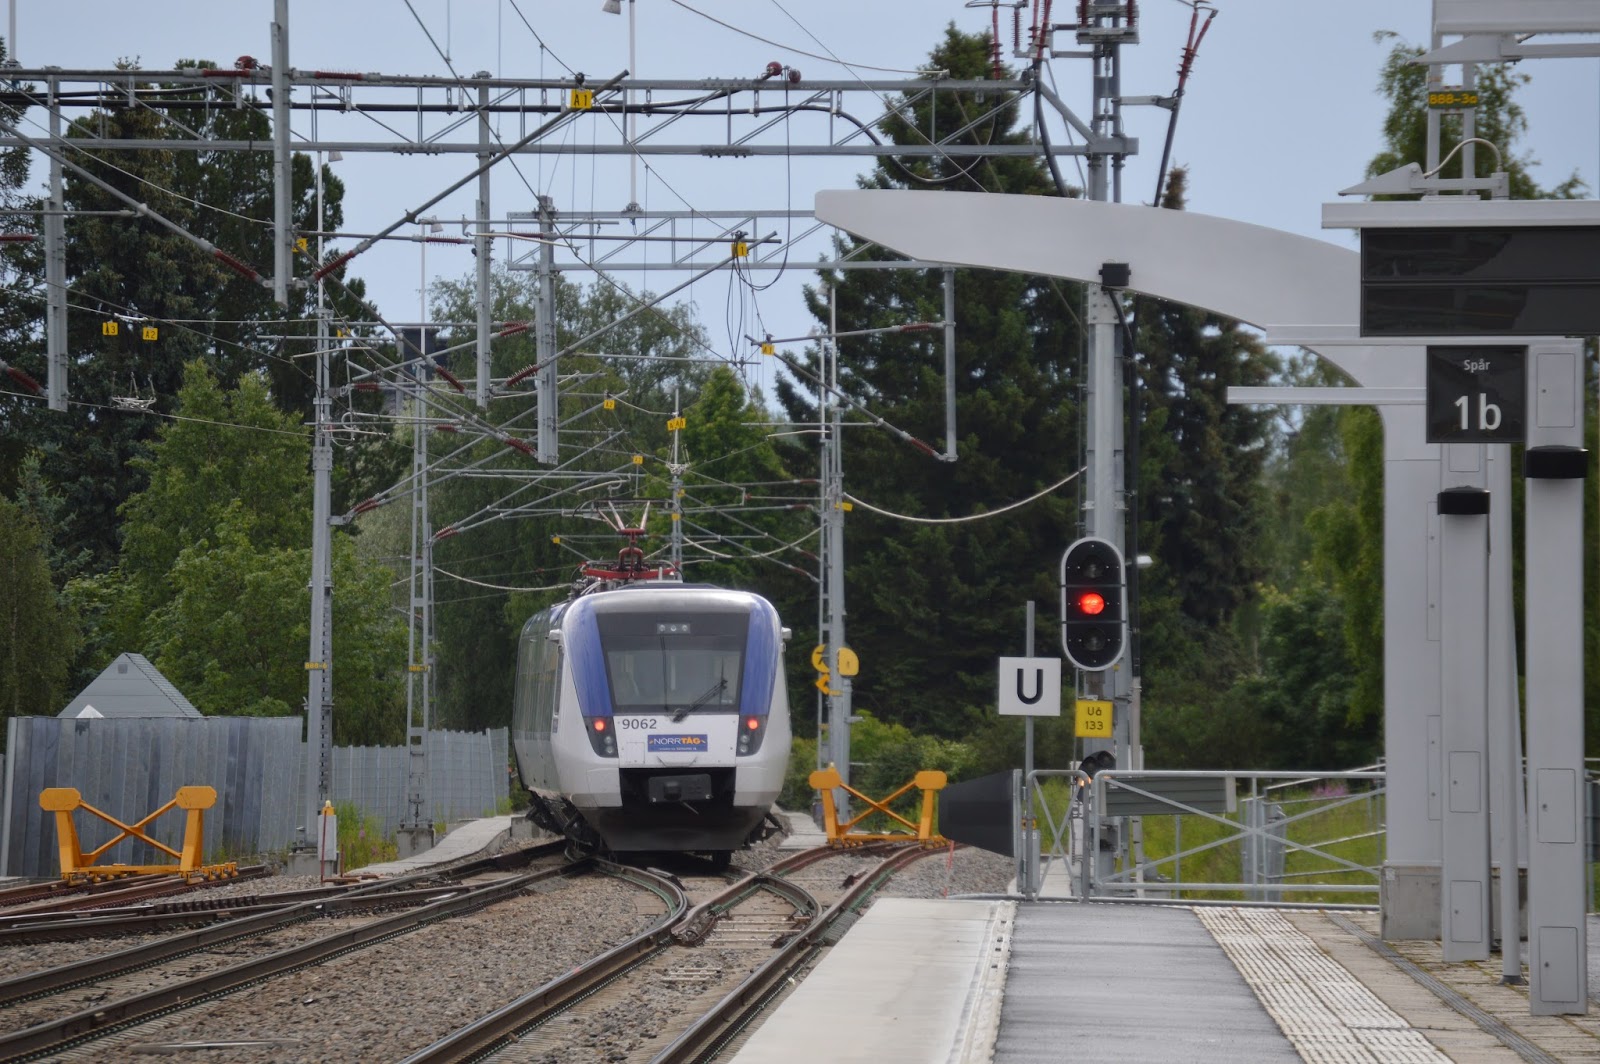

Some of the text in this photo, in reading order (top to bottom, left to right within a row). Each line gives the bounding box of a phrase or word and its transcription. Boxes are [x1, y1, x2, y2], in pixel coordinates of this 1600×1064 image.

[145, 330, 156, 339] A2
[1463, 358, 1491, 373] Spår
[1454, 393, 1502, 430] 1b
[1016, 668, 1044, 705] U
[622, 718, 657, 730] 9062
[1085, 720, 1104, 730] 133
[653, 736, 701, 745] NORRTÅG
